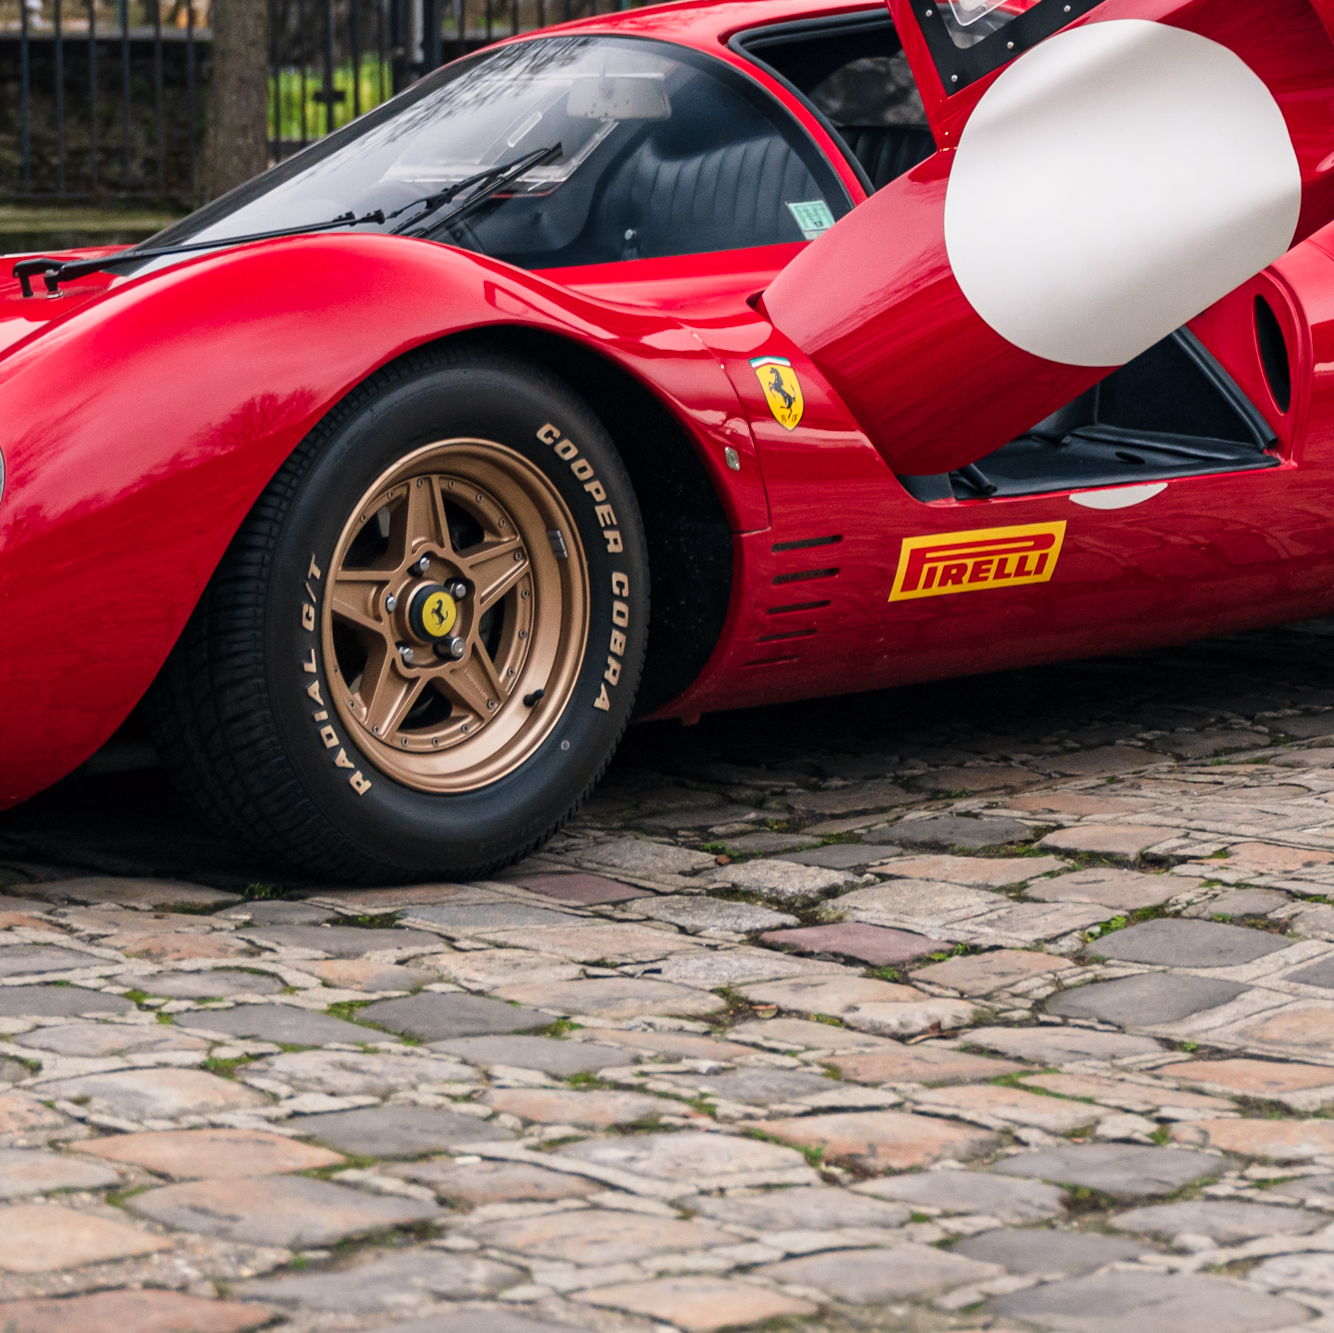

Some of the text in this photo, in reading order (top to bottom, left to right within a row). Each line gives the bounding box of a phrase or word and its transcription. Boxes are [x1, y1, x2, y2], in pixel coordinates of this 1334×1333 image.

[301, 553, 372, 796] RADIAL G/T
[536, 422, 629, 711] COOPER COBRA
[899, 532, 1056, 592] PIRELLI
